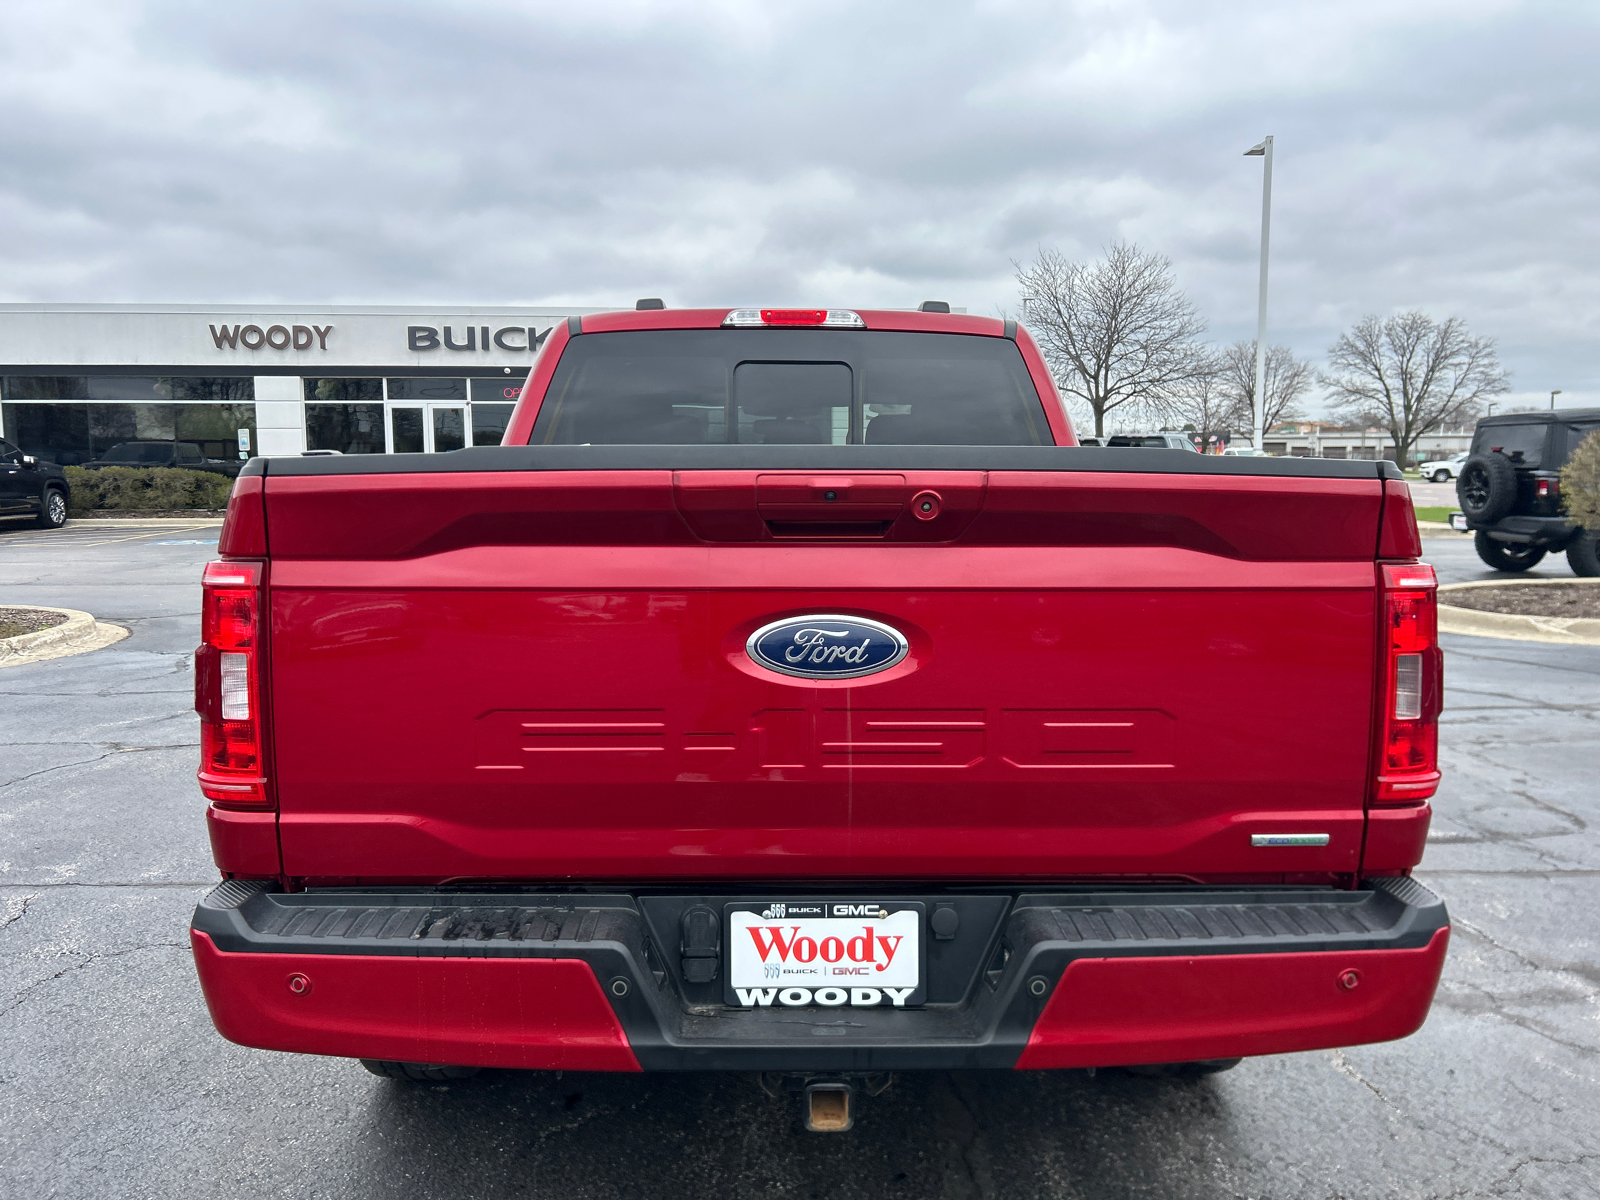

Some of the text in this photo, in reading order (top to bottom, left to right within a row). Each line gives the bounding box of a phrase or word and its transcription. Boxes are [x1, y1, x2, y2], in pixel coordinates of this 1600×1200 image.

[208, 324, 334, 350] WOODY
[407, 326, 554, 351] BUICK
[503, 387, 524, 398] OP
[785, 628, 871, 664] Ford
[474, 708, 1177, 770] F-150
[833, 904, 880, 916] GMC
[745, 926, 904, 972] Woody
[832, 967, 870, 976] GMC
[735, 987, 916, 1007] WOODY
